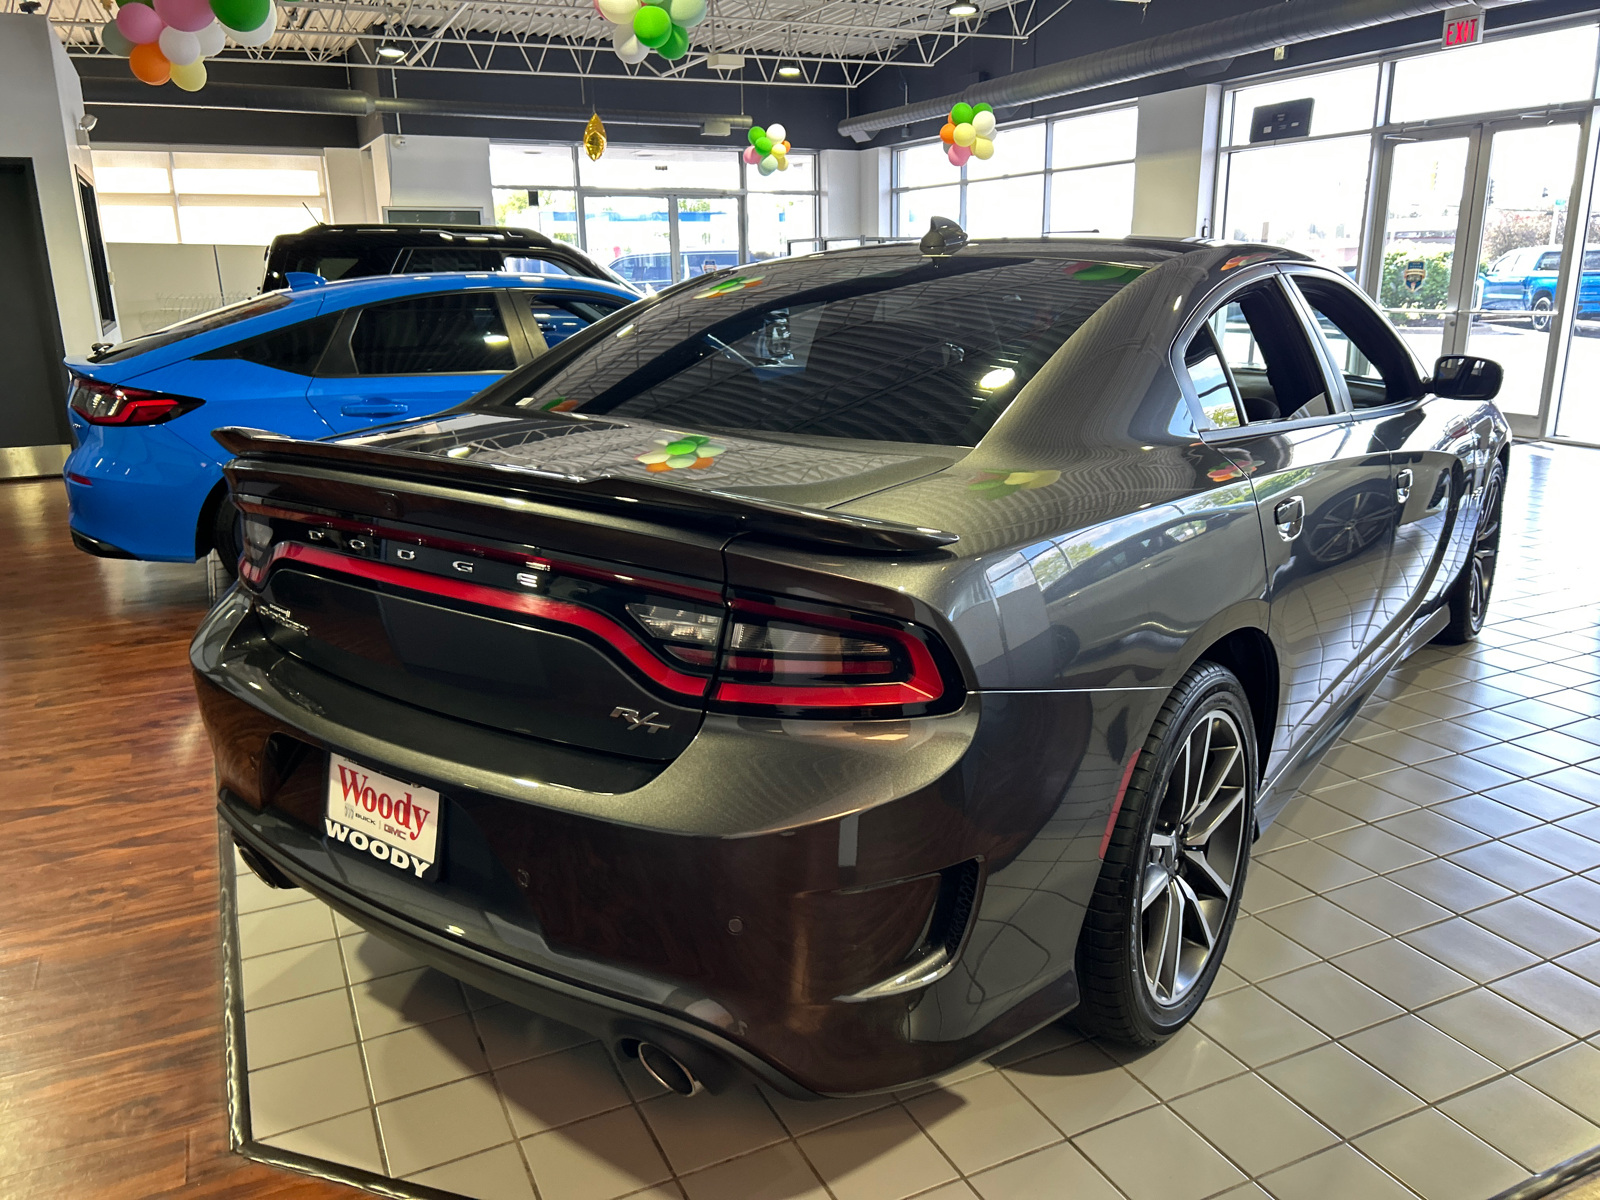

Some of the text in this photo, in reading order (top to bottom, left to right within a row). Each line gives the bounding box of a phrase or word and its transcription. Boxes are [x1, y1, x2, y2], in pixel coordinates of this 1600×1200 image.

[1446, 18, 1478, 46] EXIT
[308, 529, 538, 588] DODGE
[609, 706, 671, 734] R/T
[337, 764, 431, 841] Woody
[355, 812, 407, 840] BUICK GMC
[324, 818, 431, 878] WOODY
